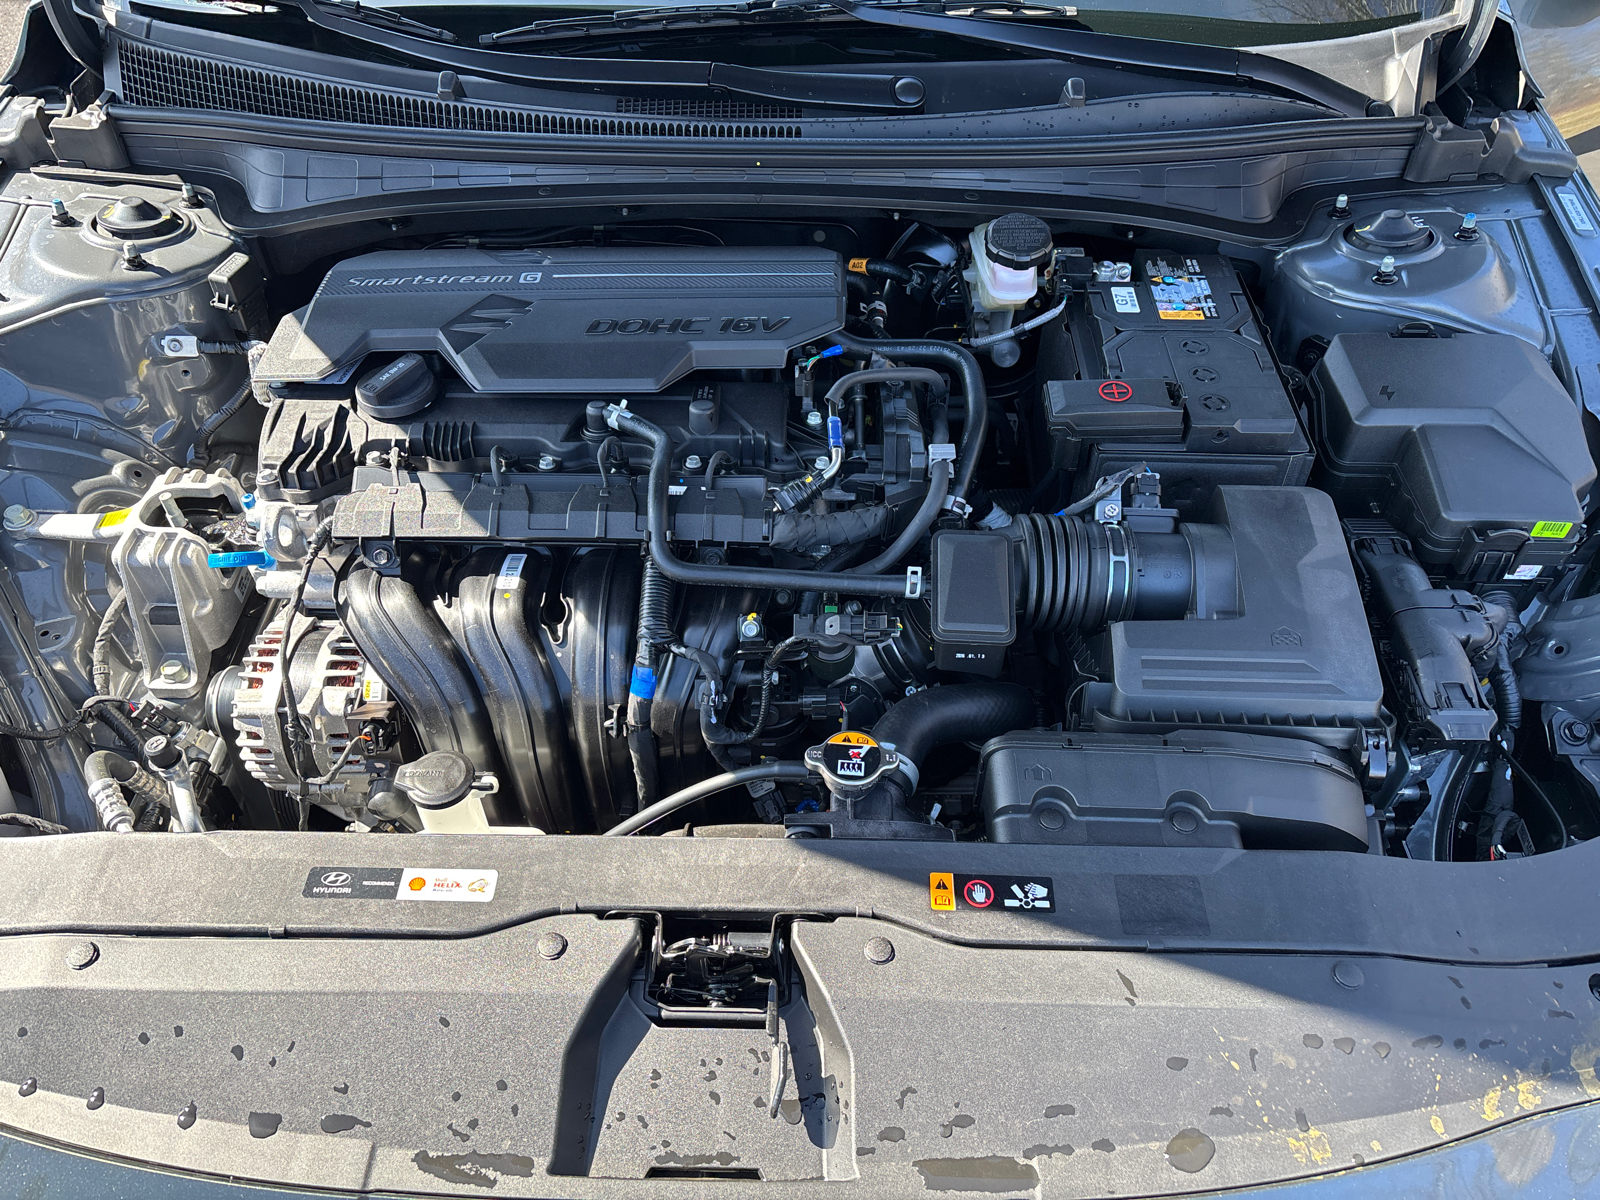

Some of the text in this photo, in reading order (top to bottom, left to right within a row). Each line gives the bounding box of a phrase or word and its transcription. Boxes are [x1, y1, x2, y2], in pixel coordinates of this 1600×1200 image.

[852, 261, 864, 269] A02
[347, 274, 514, 287] Smartstream
[1114, 293, 1128, 306] G7
[584, 316, 792, 335] DOHC 16V
[380, 371, 391, 382] SAE
[434, 880, 462, 888] HELIX
